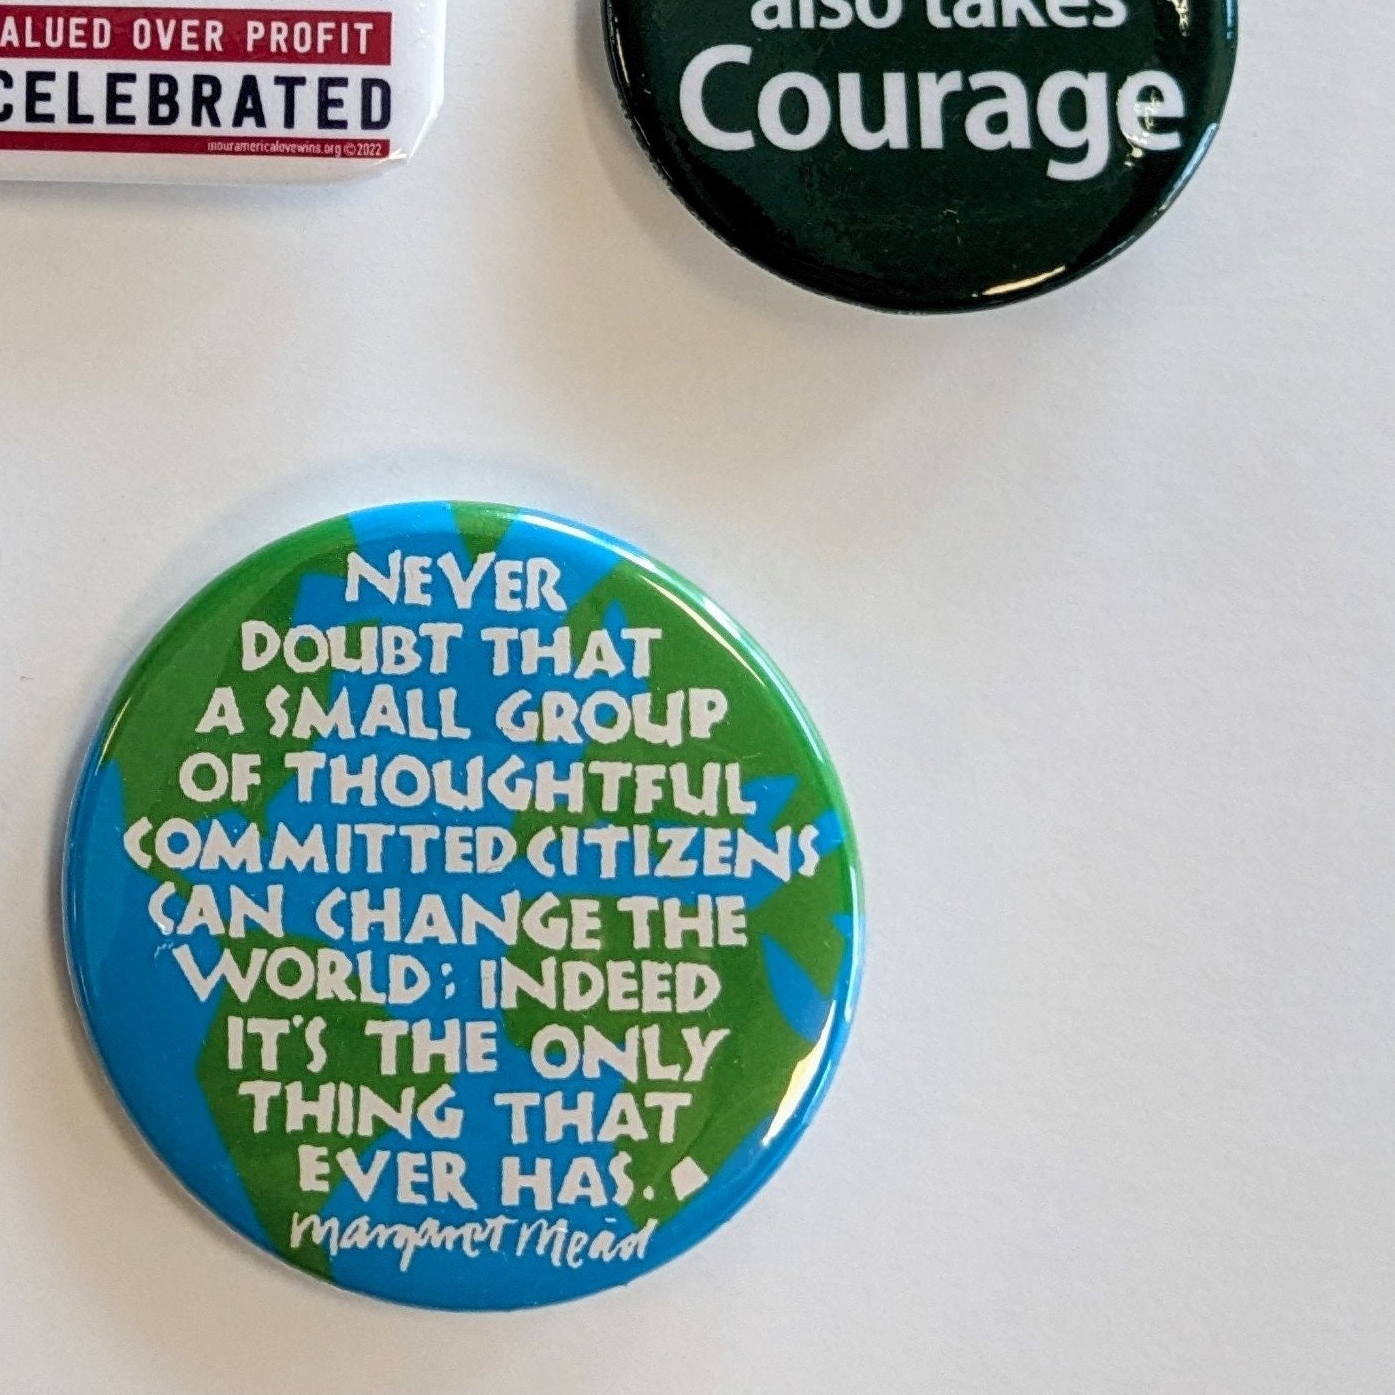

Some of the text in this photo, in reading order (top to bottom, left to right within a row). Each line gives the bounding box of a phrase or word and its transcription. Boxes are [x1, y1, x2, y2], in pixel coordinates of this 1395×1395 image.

[132, 18, 223, 52] OVER
[246, 20, 373, 55] PROFIT
[678, 43, 1186, 181] Courage
[207, 139, 342, 156] inouramericalovewins.org
[345, 549, 568, 613] NEVER
[240, 620, 662, 680] DOUBT THAT
[195, 685, 728, 748] A SMALL GROUP
[178, 751, 757, 817] OF THOUGHTFUL
[123, 816, 820, 883] COMMITTED CITIZENS
[148, 882, 747, 951] CAN CHANGE THE
[481, 958, 722, 1013] INDEED
[227, 1015, 730, 1083] IT'S THE ONLY
[238, 1081, 692, 1145] THING THAT
[297, 1144, 655, 1211] EVER HAS.
